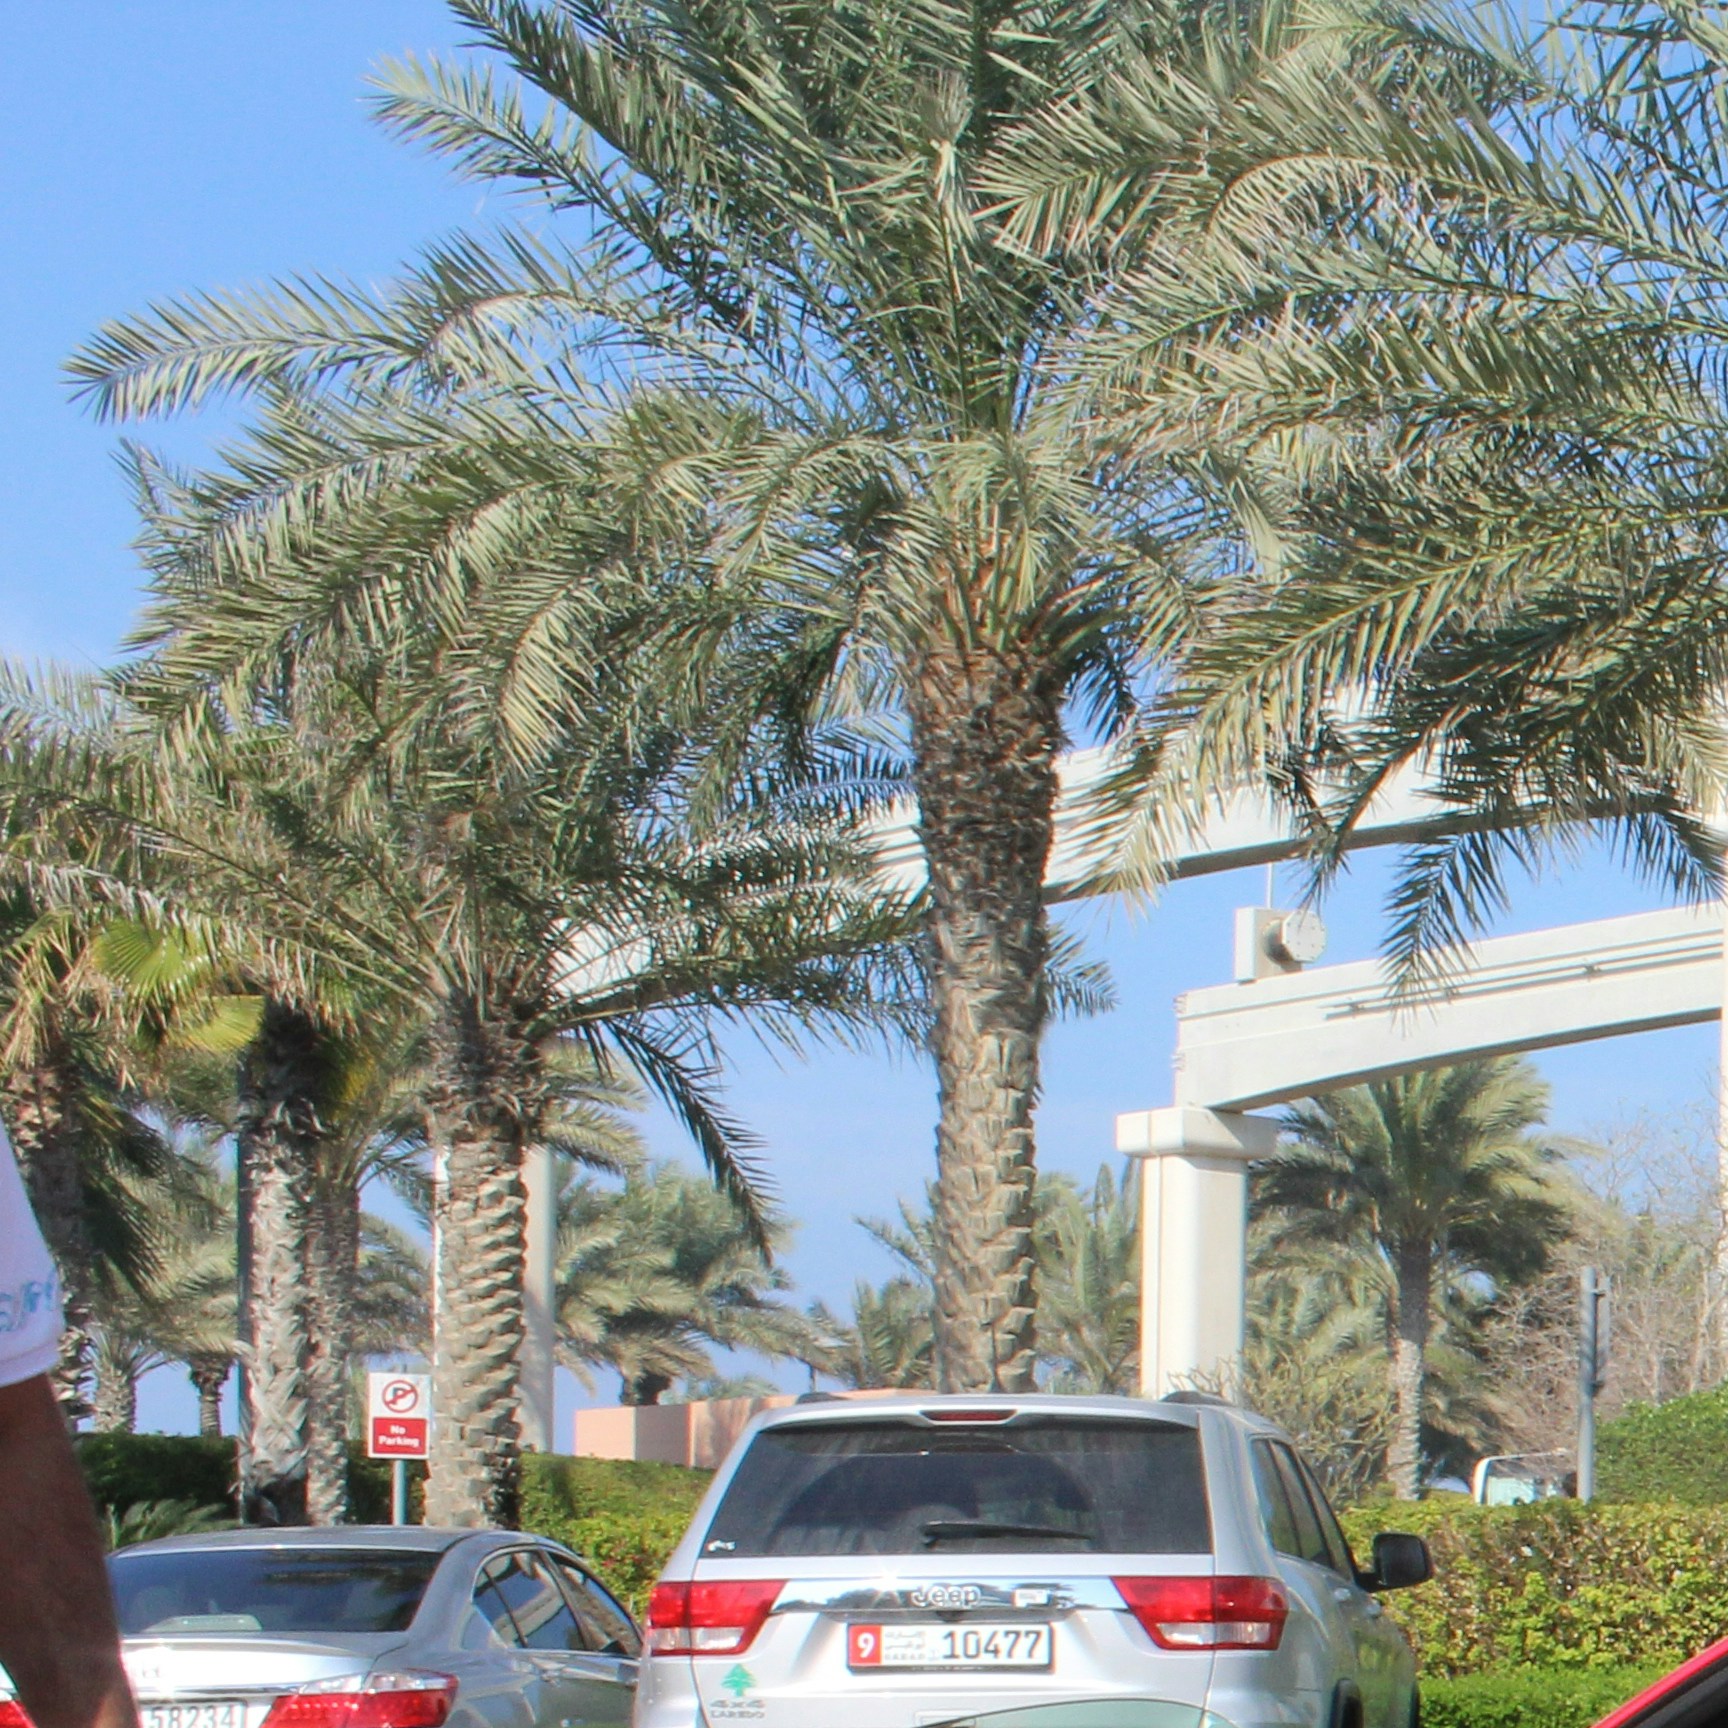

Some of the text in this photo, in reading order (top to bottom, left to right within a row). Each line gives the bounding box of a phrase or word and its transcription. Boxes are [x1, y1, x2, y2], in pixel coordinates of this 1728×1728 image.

[390, 1425, 406, 1434] No
[379, 1435, 420, 1448] Parking
[911, 1585, 981, 1609] Jeep
[857, 1632, 876, 1659] 9
[942, 1630, 1043, 1659] 10477
[711, 1710, 765, 1719] LAREDO
